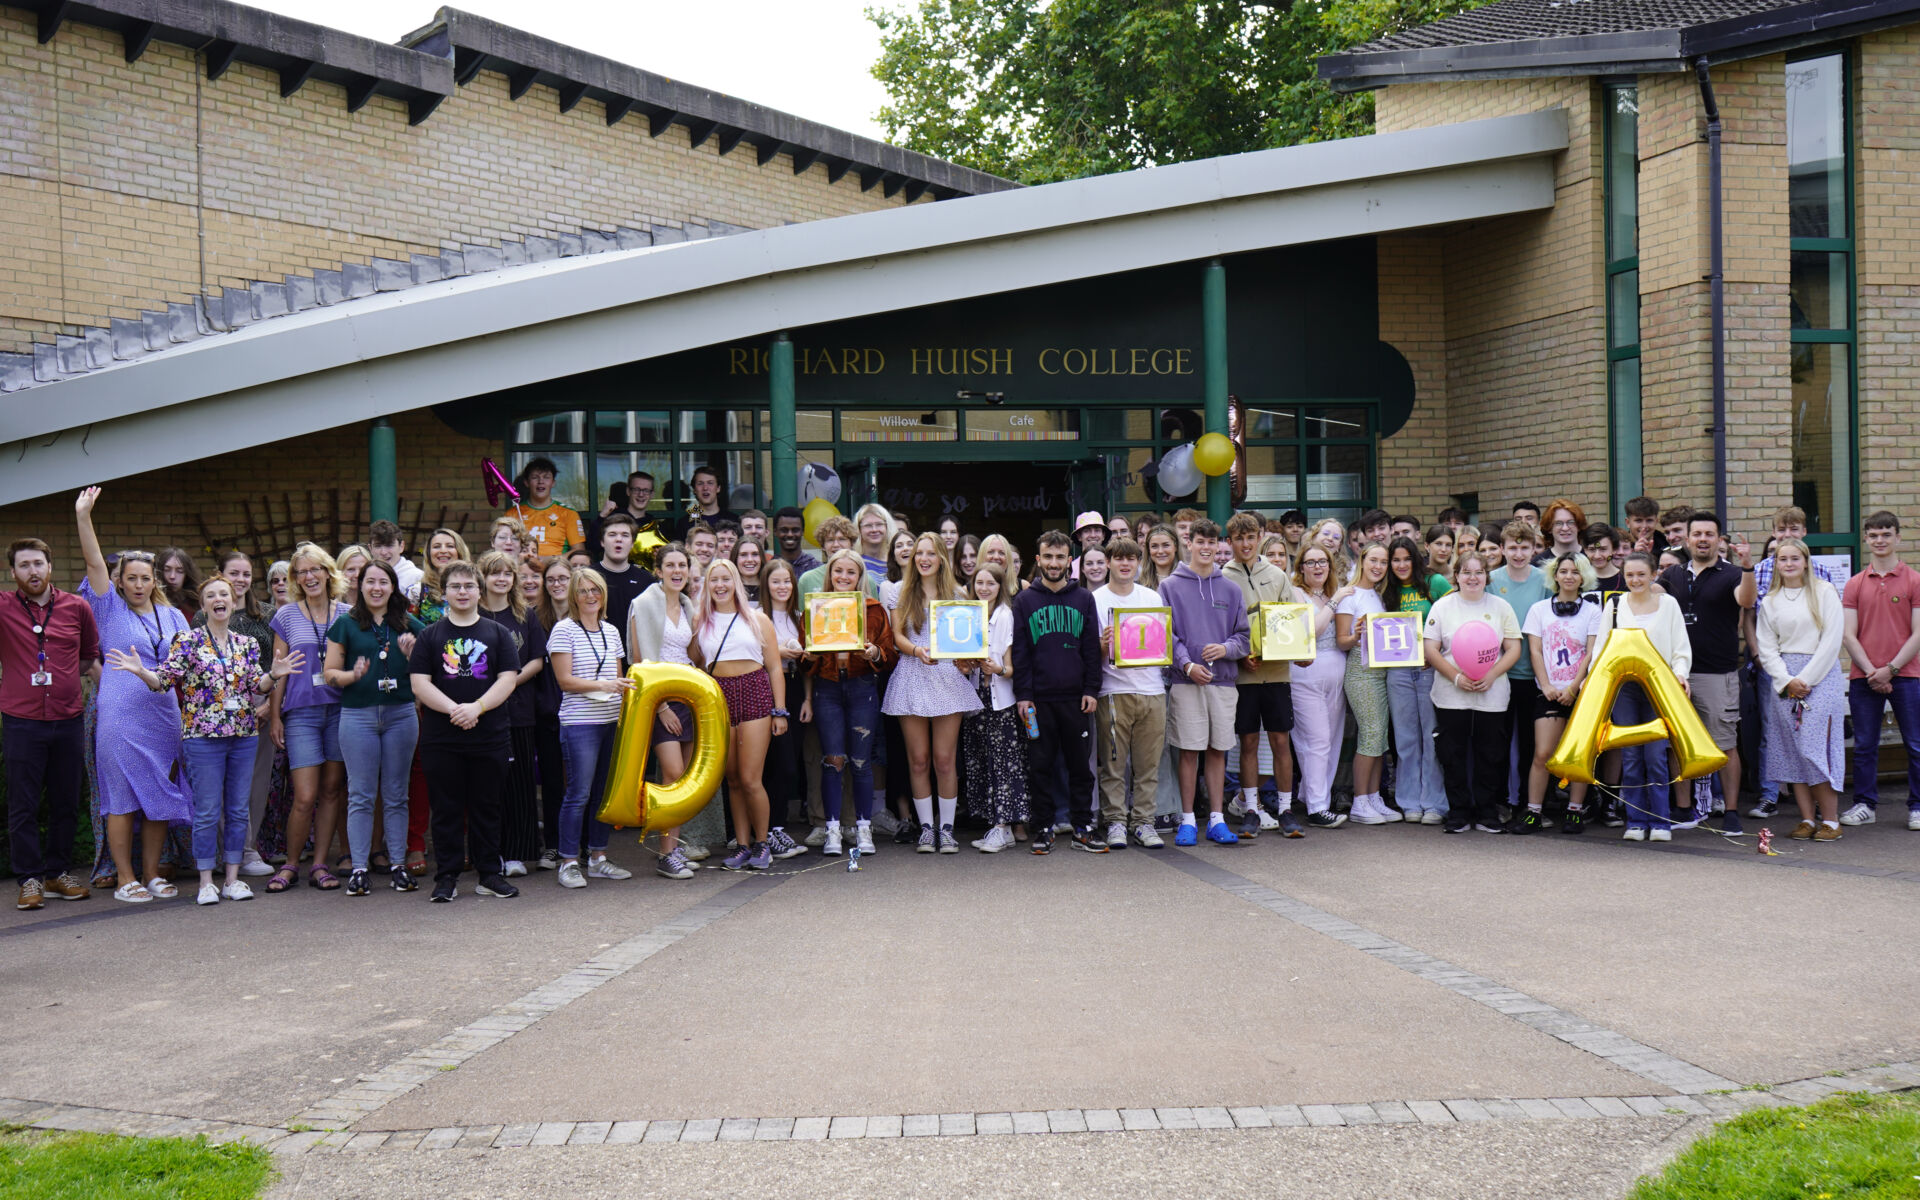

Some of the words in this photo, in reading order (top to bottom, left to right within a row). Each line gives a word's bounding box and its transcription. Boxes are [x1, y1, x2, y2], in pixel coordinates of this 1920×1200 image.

[911, 348, 1014, 375] HUISH
[1038, 348, 1195, 375] COLLEGE
[879, 415, 918, 427] Willow
[1009, 415, 1034, 426] Cafe
[940, 493, 970, 514] so
[983, 486, 1053, 517] proud
[1400, 591, 1428, 604] MAIC
[823, 607, 851, 634] H
[945, 616, 975, 643] U
[1277, 621, 1294, 645] S
[1136, 623, 1149, 650] I
[1381, 624, 1410, 651] H
[1545, 628, 1729, 785] A
[595, 660, 731, 832] D
